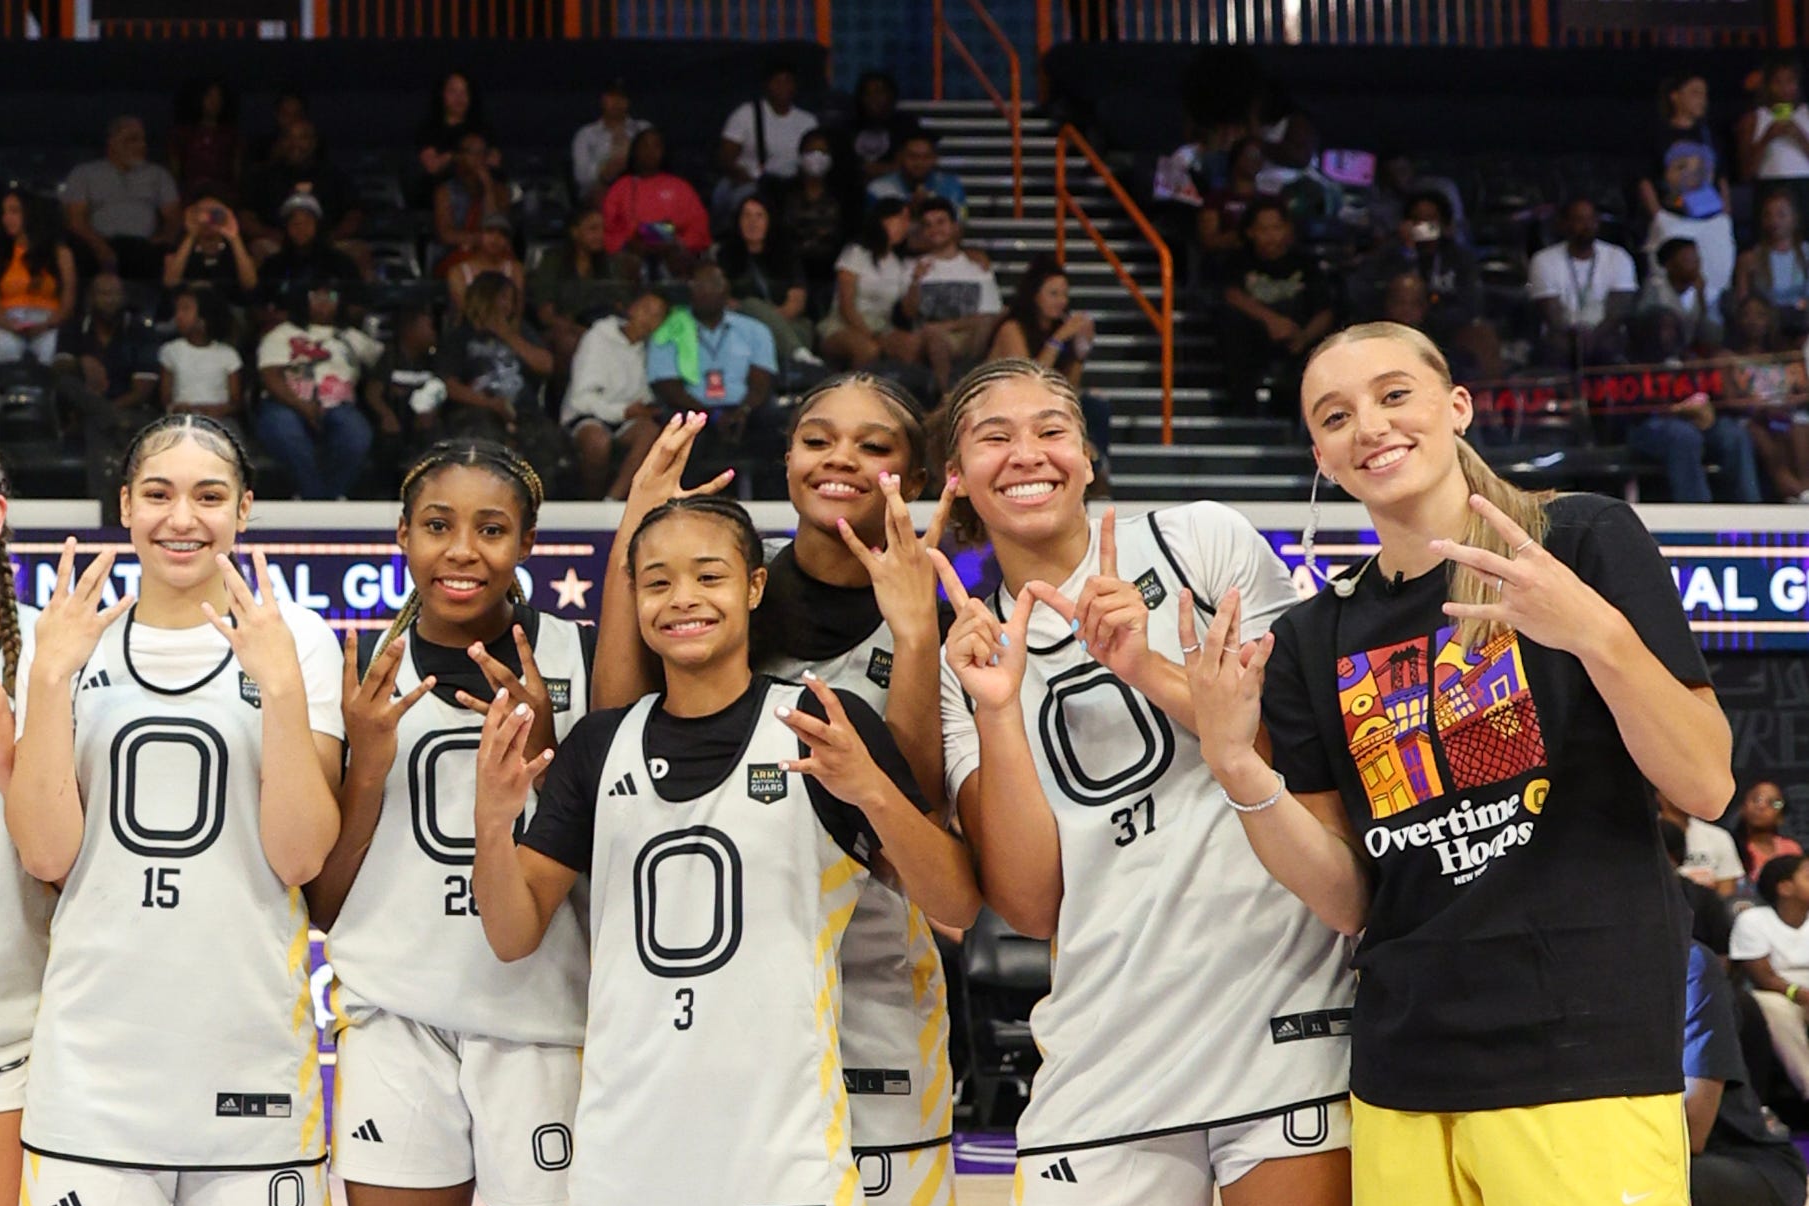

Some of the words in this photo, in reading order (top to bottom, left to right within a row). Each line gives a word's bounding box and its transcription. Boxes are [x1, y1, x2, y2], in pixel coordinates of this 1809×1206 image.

[751, 770, 783, 779] ARMY
[751, 784, 784, 793] GUARD
[1110, 793, 1156, 847] 37
[1364, 794, 1521, 858] Overtime
[141, 867, 180, 909] 15
[674, 988, 694, 1031] 3
